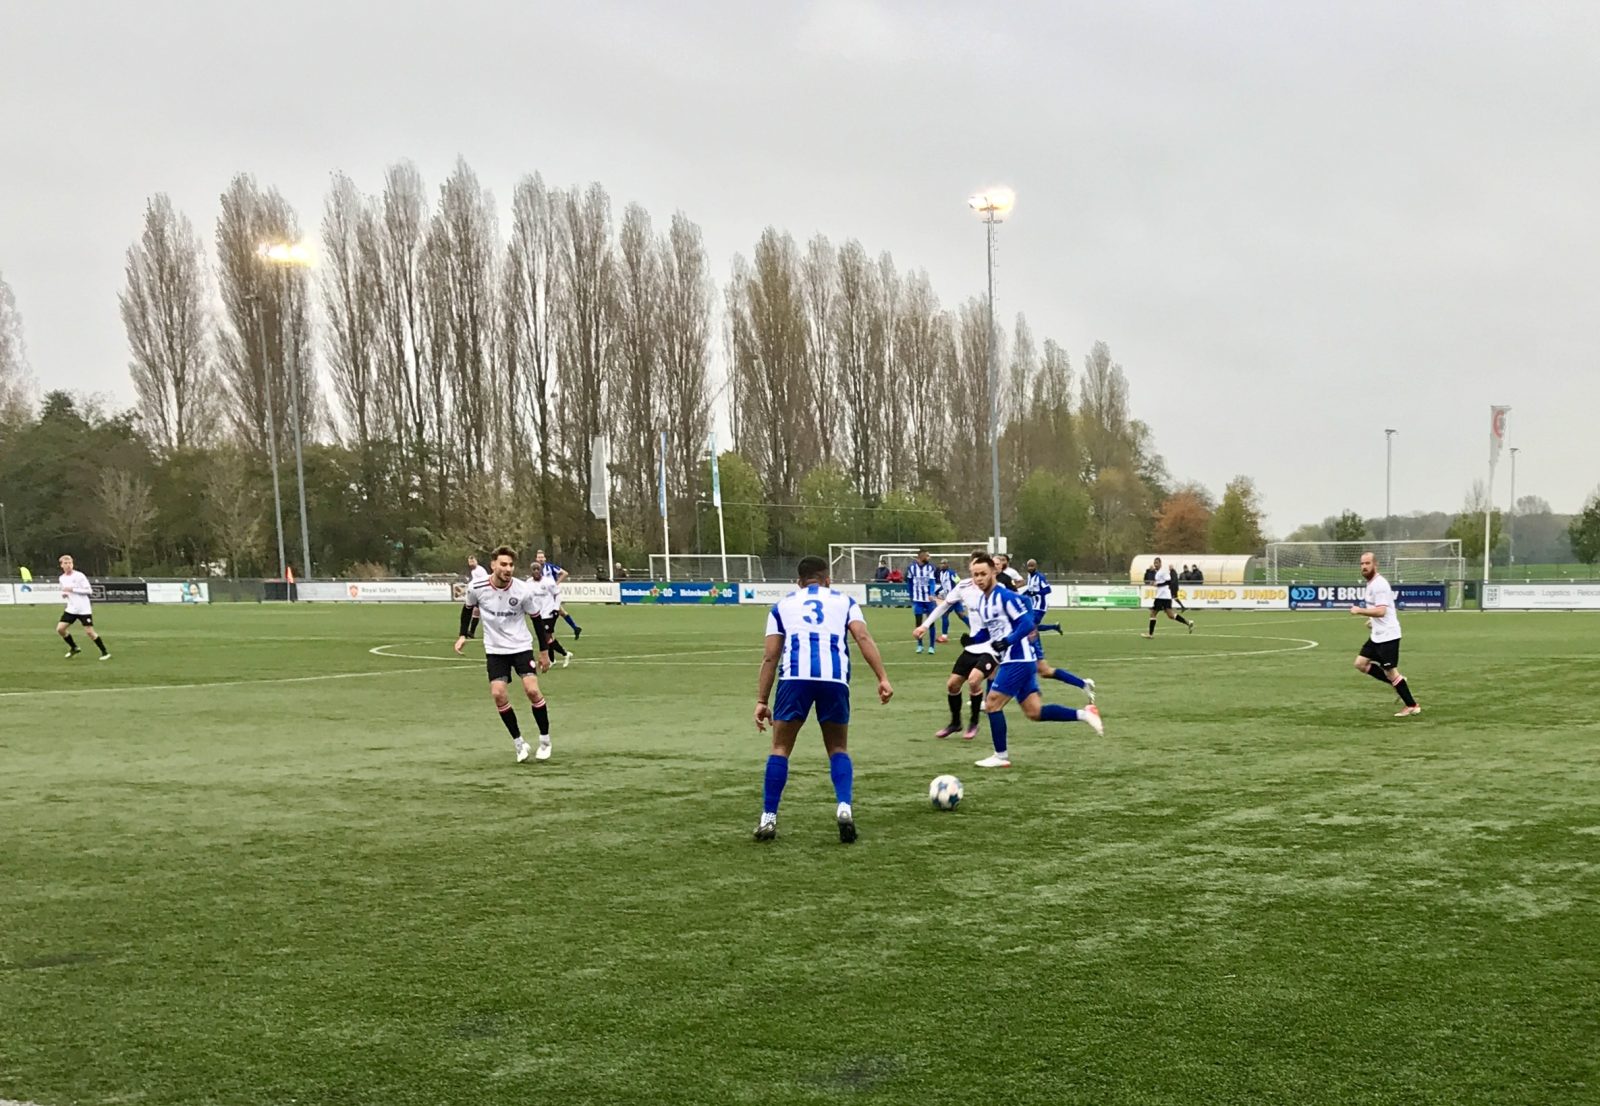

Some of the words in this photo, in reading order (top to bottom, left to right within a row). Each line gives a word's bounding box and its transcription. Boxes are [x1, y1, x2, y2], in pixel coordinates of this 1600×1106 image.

[621, 588, 650, 596] Heineken
[680, 588, 710, 597] Heineken
[1192, 589, 1237, 600] JUMBO
[1242, 589, 1286, 600] JUMBO
[1318, 587, 1335, 600] DE
[1338, 587, 1367, 601] BRU
[802, 599, 825, 625] 3
